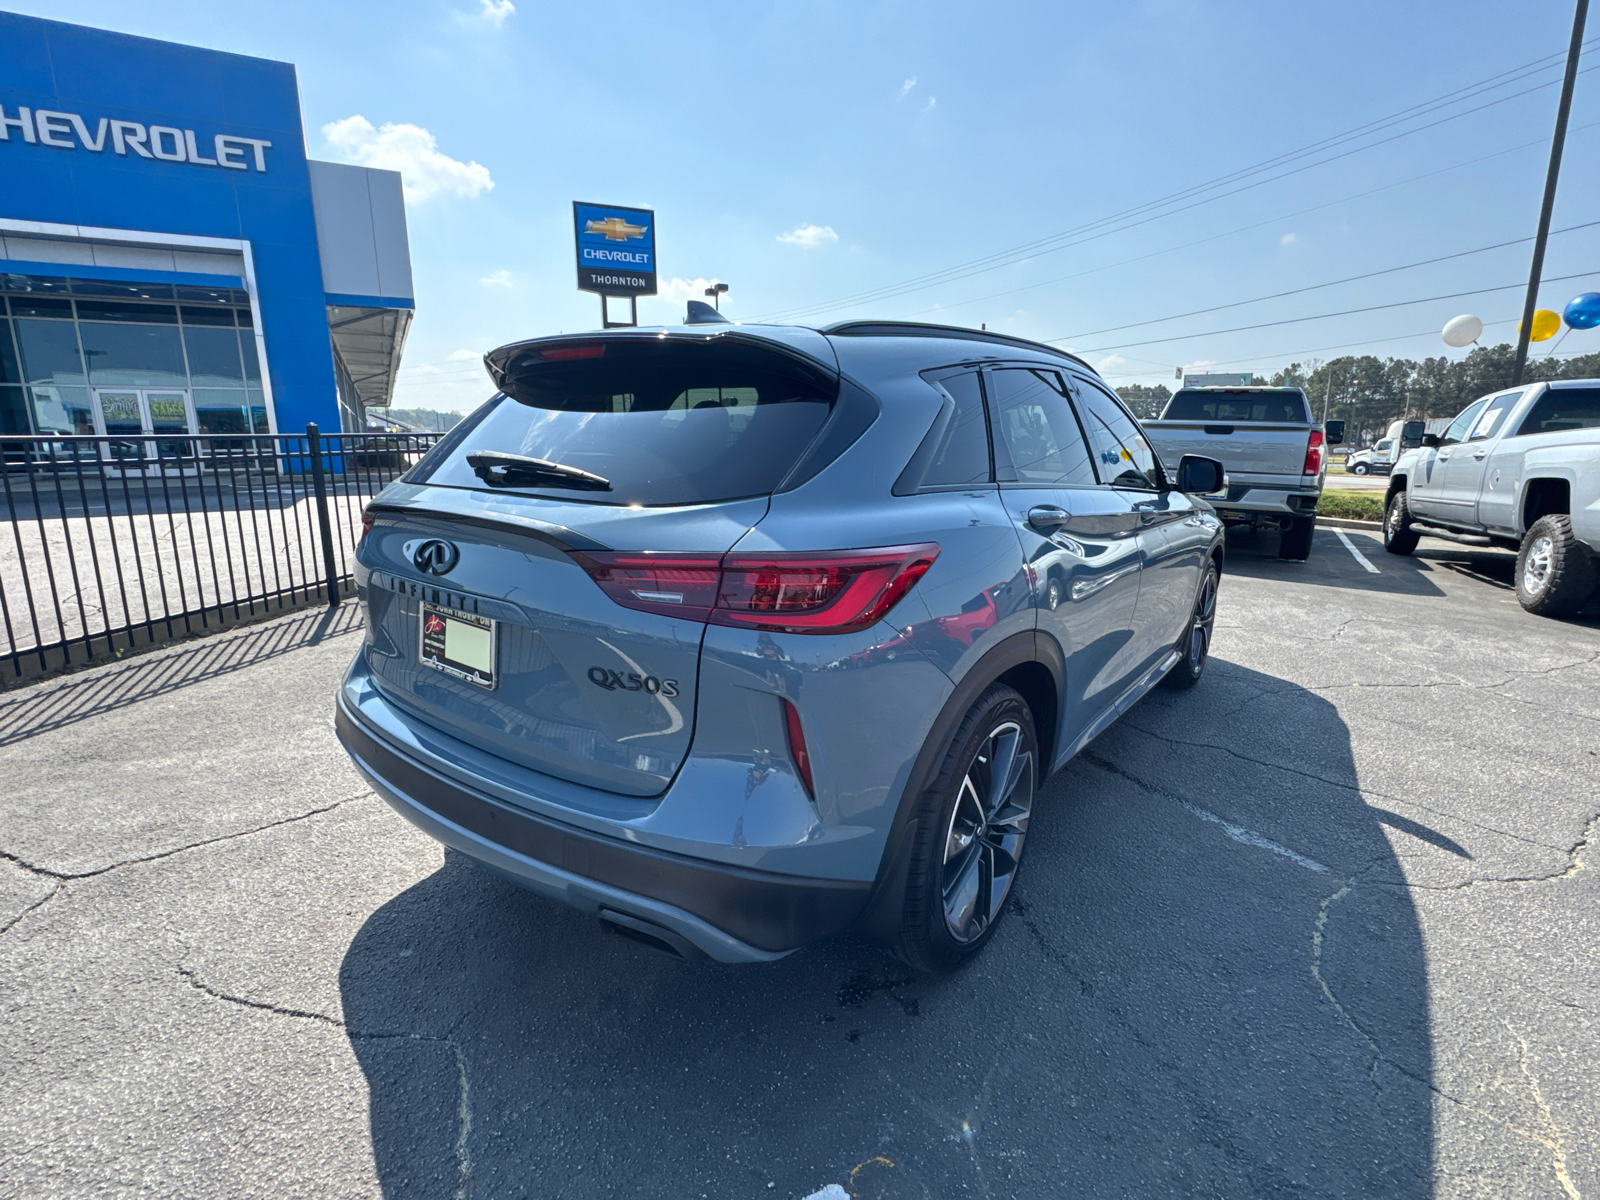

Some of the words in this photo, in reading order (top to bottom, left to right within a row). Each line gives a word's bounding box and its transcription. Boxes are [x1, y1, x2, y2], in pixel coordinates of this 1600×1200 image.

[583, 248, 649, 264] CHEVROLET
[591, 274, 646, 287] THORNTON
[391, 577, 479, 613] INFINITI
[587, 666, 679, 698] QX50S
